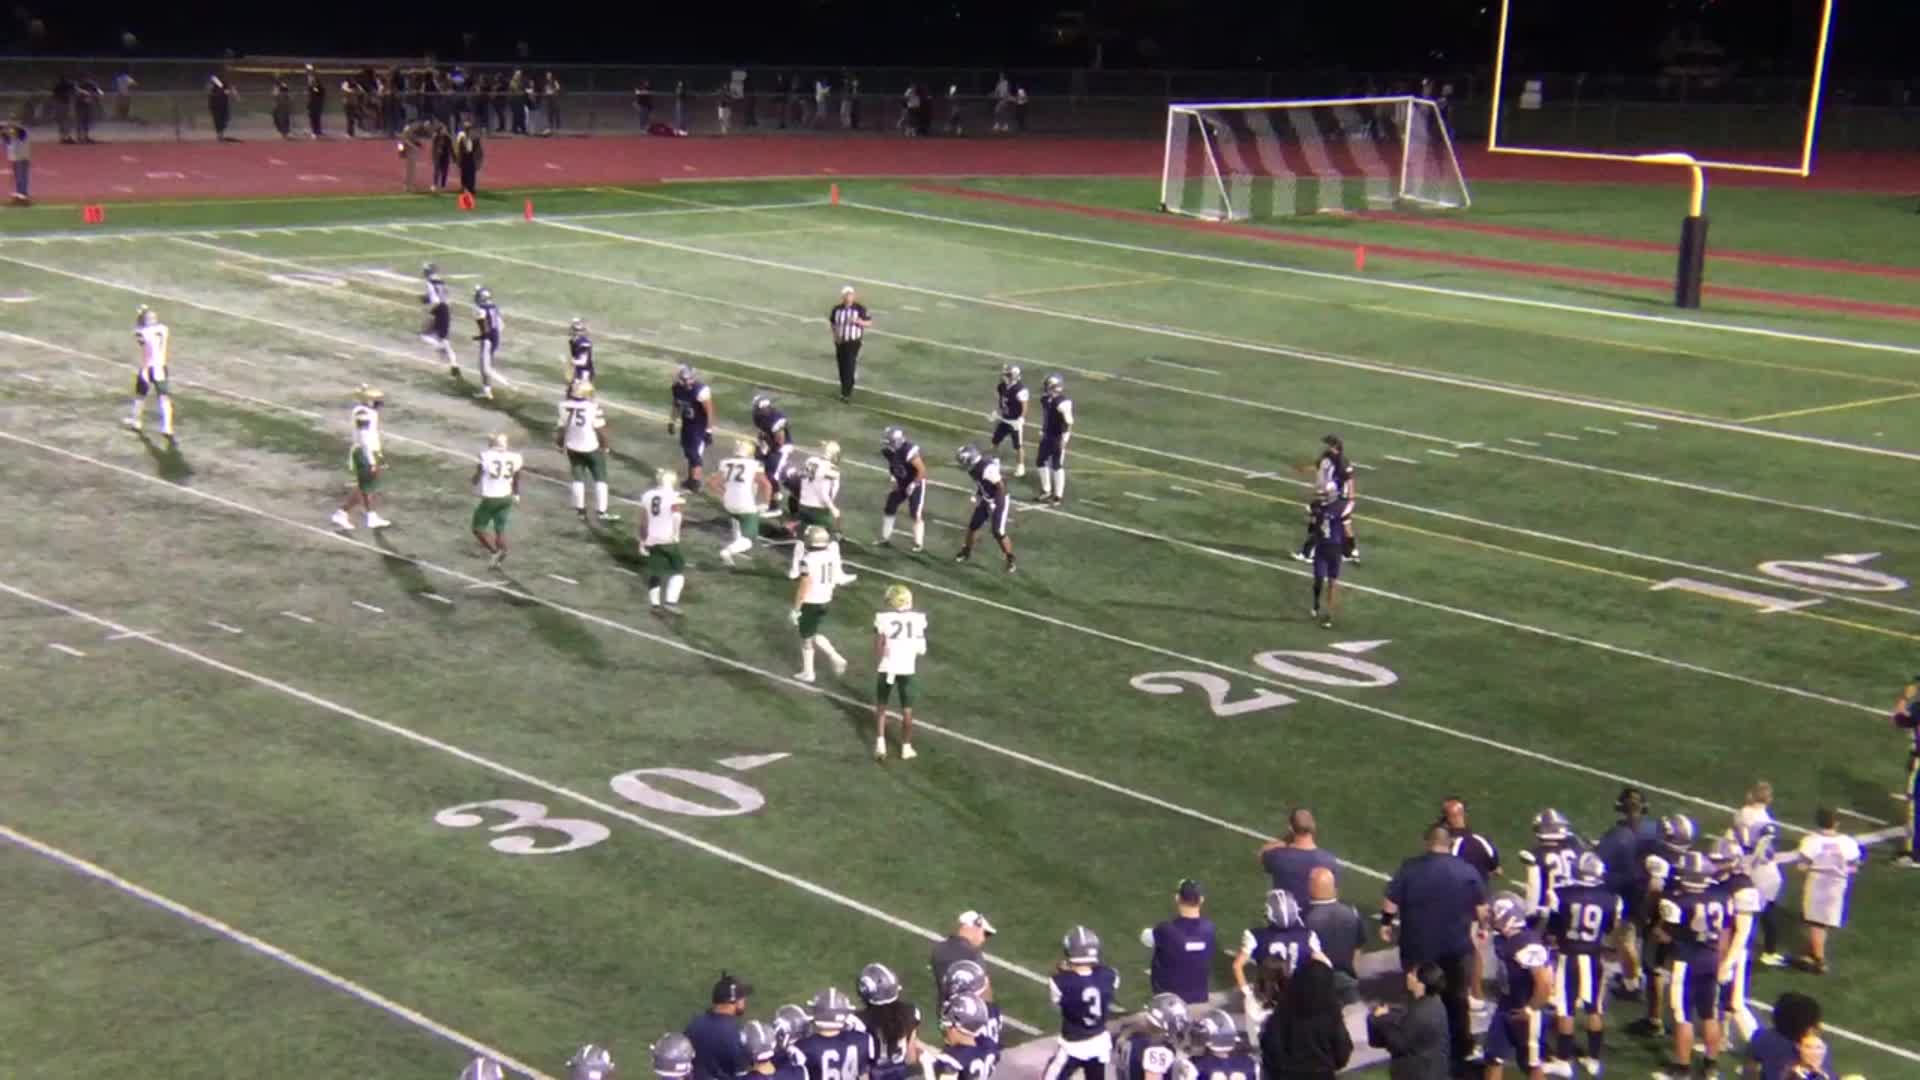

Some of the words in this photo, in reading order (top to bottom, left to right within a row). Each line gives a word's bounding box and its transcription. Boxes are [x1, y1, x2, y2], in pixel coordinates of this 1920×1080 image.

[566, 407, 585, 426] 75
[489, 460, 513, 479] 33
[724, 463, 745, 482] 72
[651, 495, 662, 516] 8
[890, 621, 913, 639] 21
[1129, 650, 1399, 717] 20
[434, 767, 766, 854] 30
[1566, 902, 1602, 942] 19
[1081, 987, 1102, 1026] 3
[821, 1045, 859, 1080] 64
